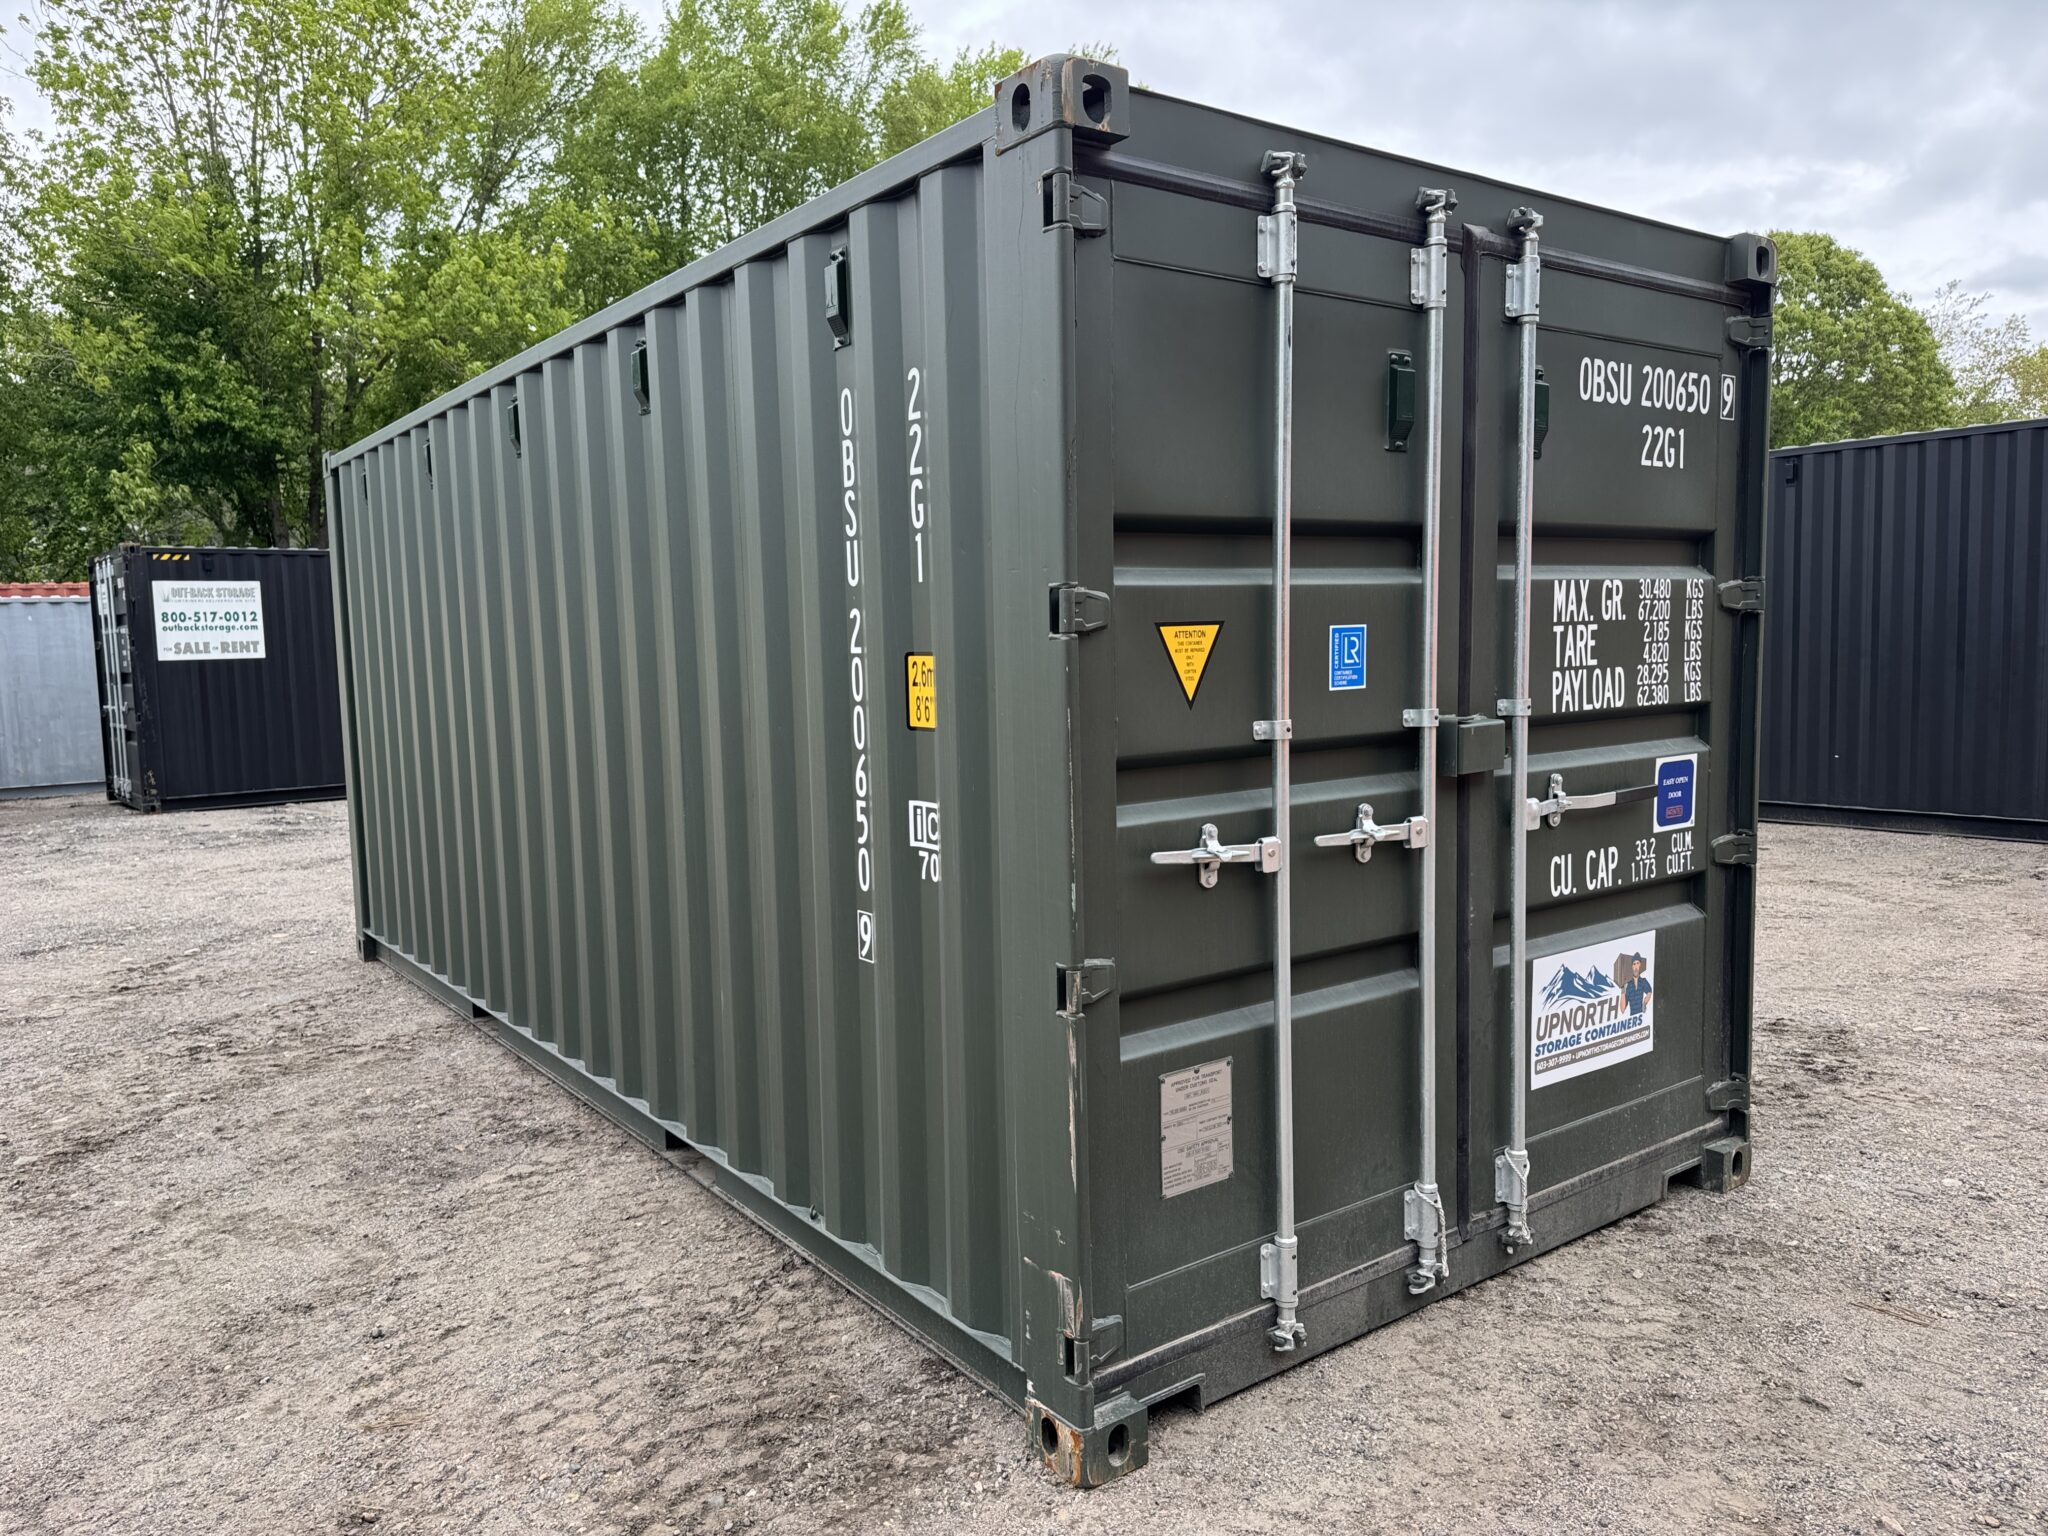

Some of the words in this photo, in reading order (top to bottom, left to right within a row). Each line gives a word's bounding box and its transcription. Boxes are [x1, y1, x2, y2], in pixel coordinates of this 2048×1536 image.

[1579, 357, 1632, 406] OBSU
[1641, 364, 1711, 415] 200650
[1722, 376, 1735, 418] 9
[1640, 424, 1685, 469] 22G1
[841, 388, 859, 586] OBSU
[907, 367, 925, 583] 22G1
[216, 587, 256, 599] STORAGE
[1553, 579, 1594, 622] MAX.
[1602, 579, 1626, 621] GR.
[1686, 578, 1704, 599] KGS
[161, 611, 258, 623] 800-517-0012
[1685, 599, 1703, 619] LBS
[162, 622, 259, 633] outbackstorage.com
[1174, 629, 1206, 639] ATTENTION
[1685, 620, 1702, 641] KGS
[173, 641, 211, 655] SALE
[220, 641, 260, 654] RENT
[1553, 624, 1598, 668] TARE
[1684, 641, 1702, 661] LBS
[1684, 661, 1702, 682] KGS
[1552, 667, 1625, 713] PAYLOAD
[1684, 682, 1702, 702] LBS
[850, 608, 870, 892] 200650
[1663, 778, 1676, 786] EASY
[1675, 776, 1689, 784] OPEN
[1668, 790, 1682, 799] DOOR
[1635, 837, 1656, 861] 33.2
[919, 850, 940, 882] 70
[1550, 853, 1577, 897] CU.
[1586, 846, 1622, 891] CAP.
[859, 913, 873, 959] 9
[1536, 995, 1620, 1041] UPNORTH
[1535, 1032, 1582, 1057] STORAGE
[1585, 1014, 1643, 1043] CONTAINERS
